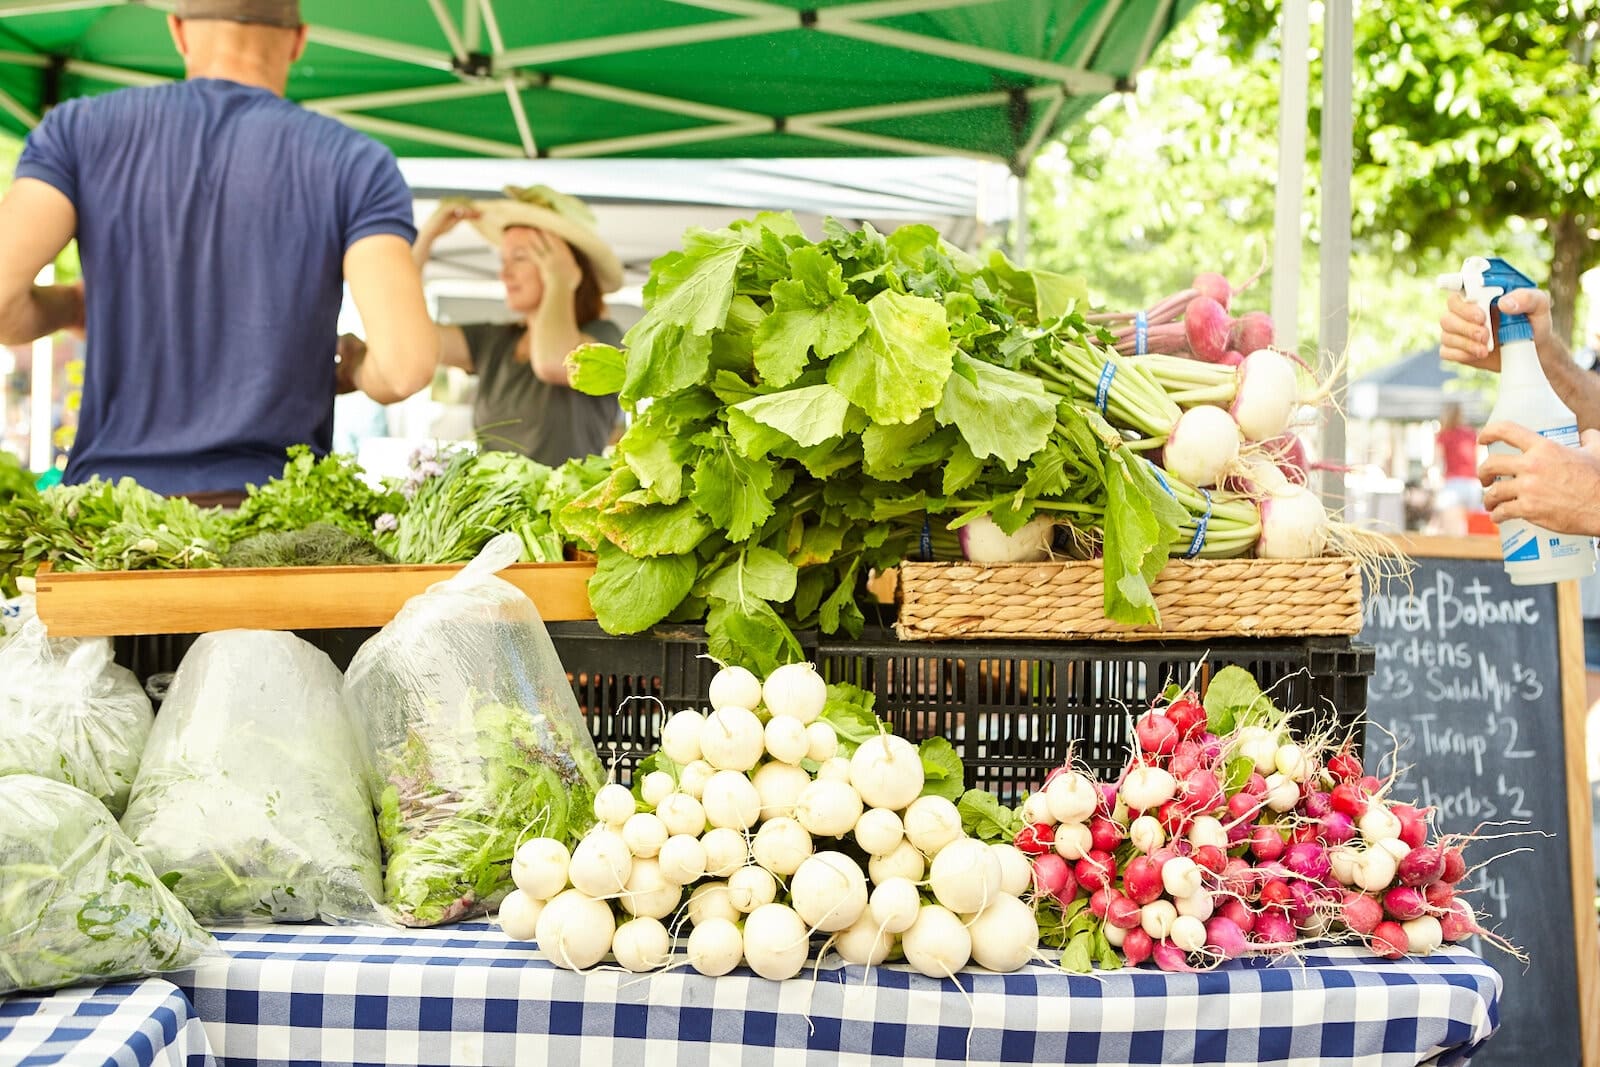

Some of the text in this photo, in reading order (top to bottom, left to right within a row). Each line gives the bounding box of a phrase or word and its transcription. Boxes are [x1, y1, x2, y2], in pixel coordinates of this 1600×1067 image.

[1362, 570, 1540, 639] nver Botanic
[1374, 637, 1472, 669] ardens
